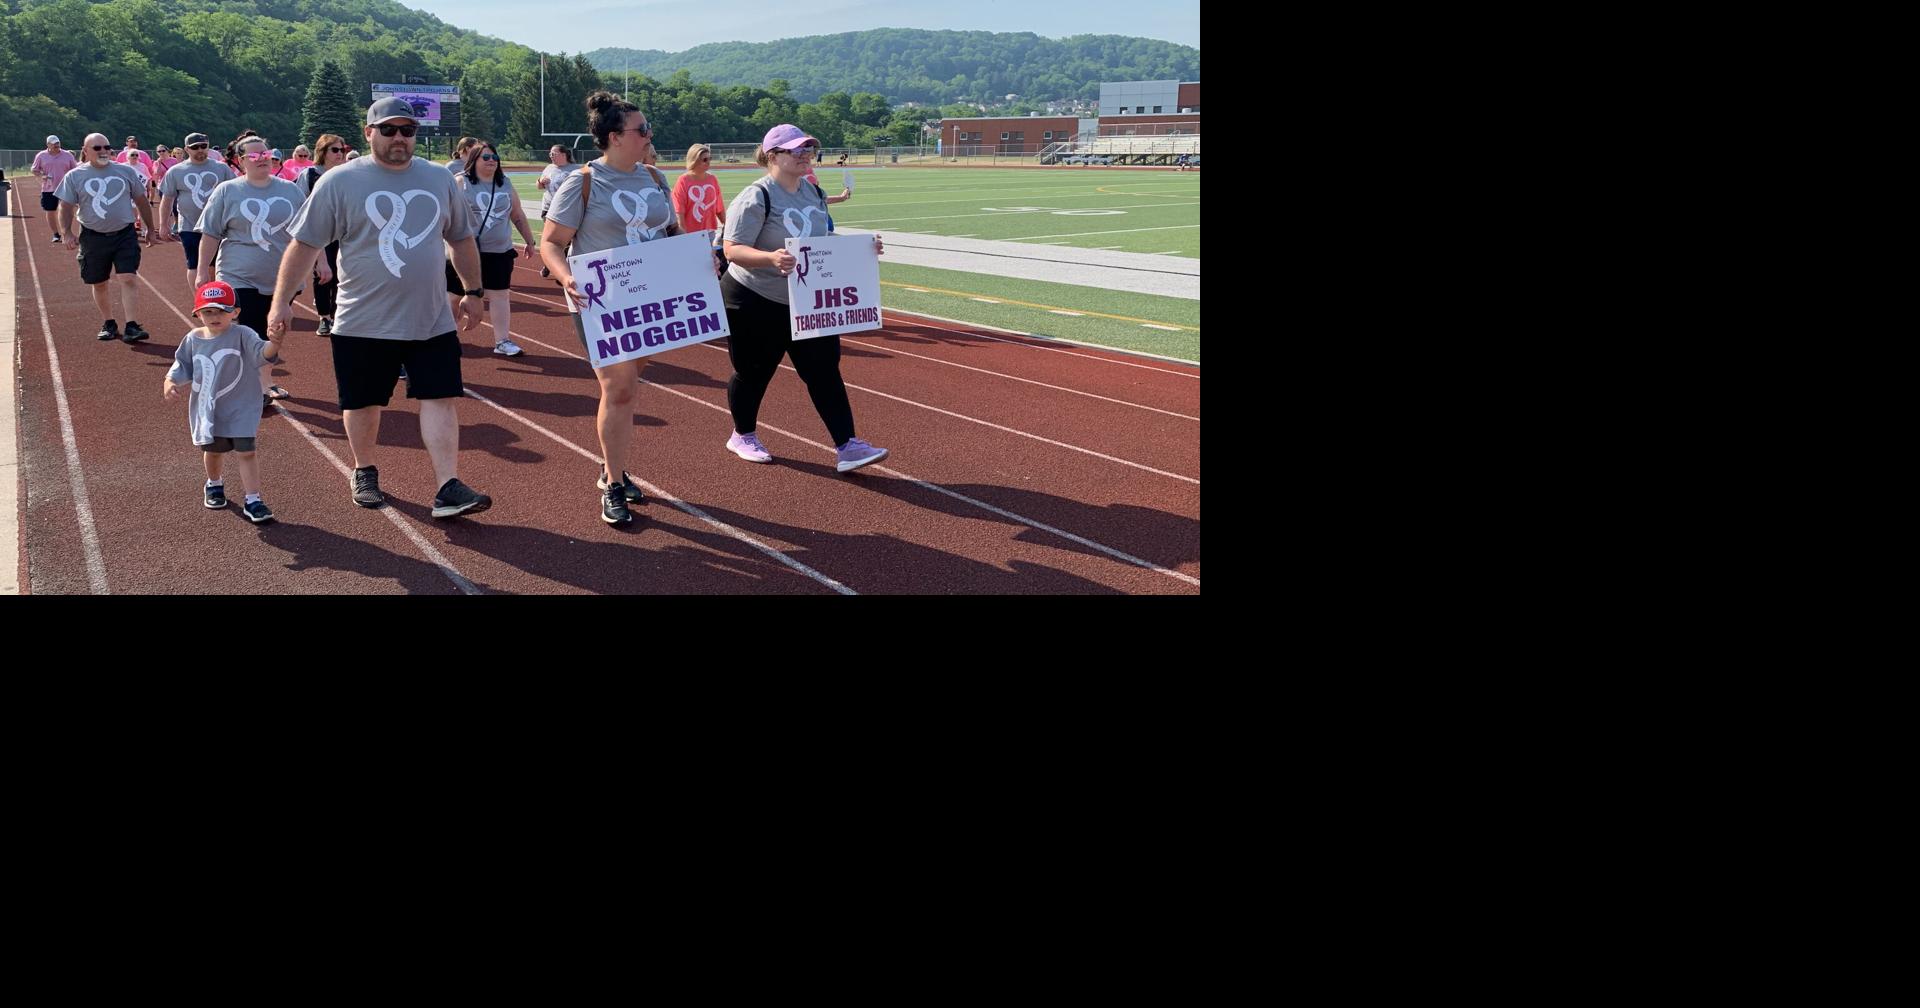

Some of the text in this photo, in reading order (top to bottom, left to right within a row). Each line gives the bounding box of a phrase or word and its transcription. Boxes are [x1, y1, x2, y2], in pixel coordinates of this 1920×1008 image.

[611, 270, 631, 280] WALK
[620, 279, 630, 287] OF
[628, 284, 648, 293] HOPE
[813, 286, 859, 310] JHS
[600, 292, 707, 333] NERF'S
[795, 306, 879, 332] TEACHERS & FRIENDS
[597, 312, 721, 359] NOGGIN
